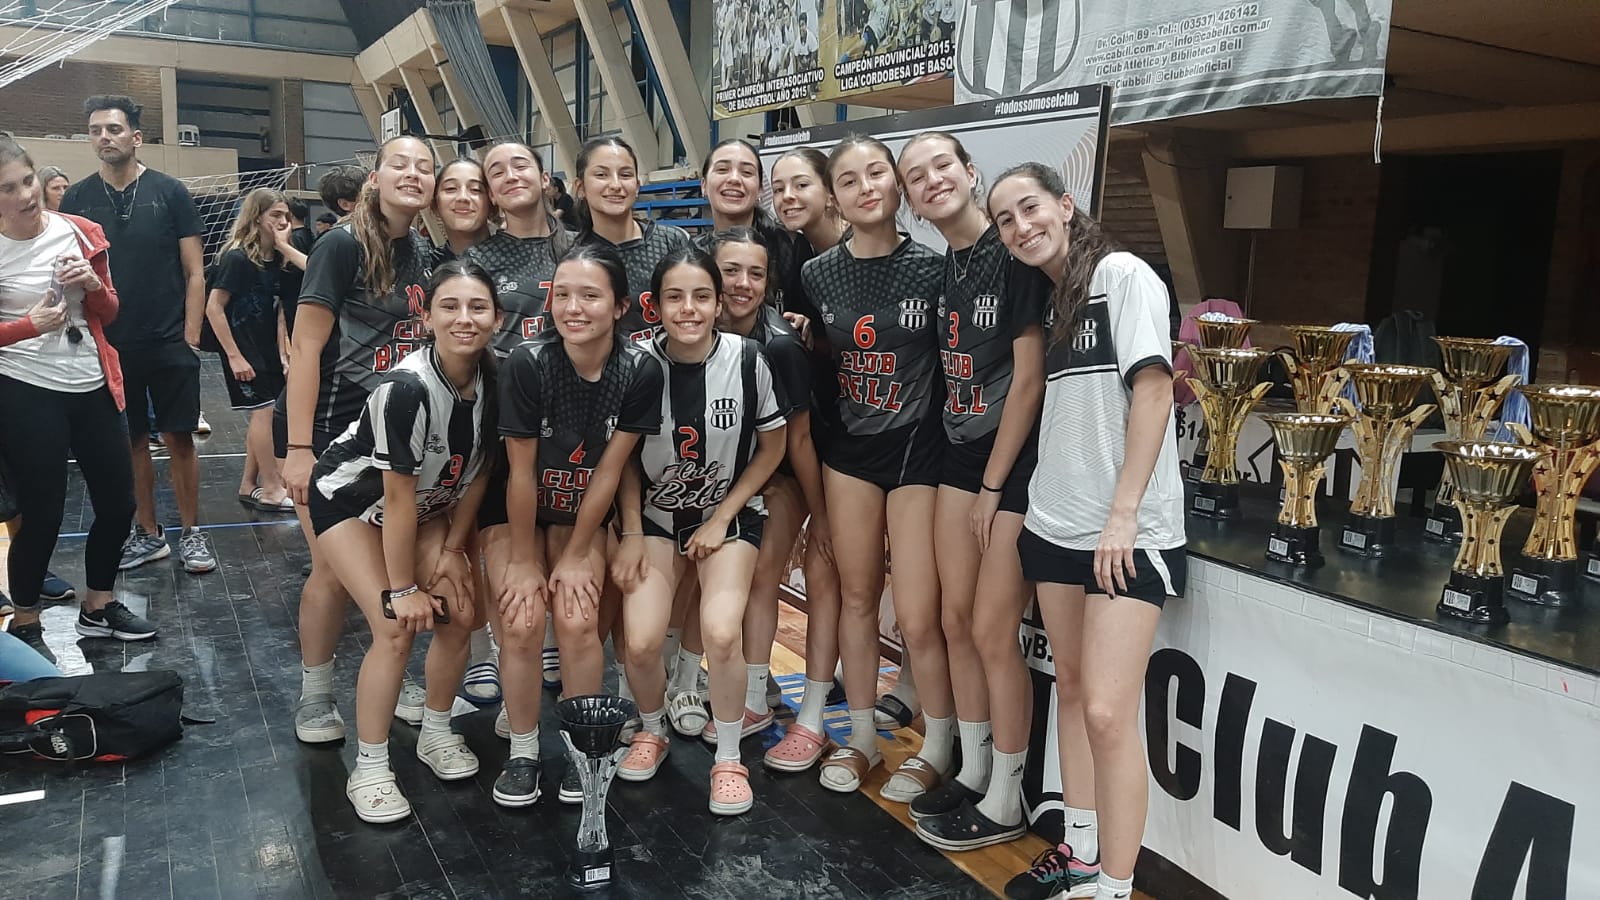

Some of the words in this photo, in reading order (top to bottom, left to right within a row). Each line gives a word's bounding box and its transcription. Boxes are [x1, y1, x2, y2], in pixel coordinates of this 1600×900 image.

[1136, 28, 1150, 40] 89
[1179, 13, 1216, 34] (03537)
[1218, 4, 1258, 20] 426142
[834, 55, 873, 77] CAMPEÓN
[874, 45, 925, 68] PROVINCIAL
[927, 39, 950, 57] 2015
[1161, 55, 1168, 66] y
[1170, 45, 1217, 62] Biblioteca
[1219, 38, 1243, 51] Bell
[716, 88, 737, 103] PRIMER
[736, 80, 765, 98] CAMPEÓN
[766, 68, 825, 92] INTERASOCIATIVO
[840, 74, 859, 91] LIGA
[860, 66, 912, 87] CORDOBESA
[913, 61, 926, 76] DE
[927, 55, 956, 73] BASQ
[728, 100, 737, 112] DE
[791, 85, 807, 99] 2015
[994, 90, 1080, 116] #todossomoselclub
[405, 283, 425, 316] 10
[639, 291, 662, 324] 8
[522, 316, 545, 340] CL
[853, 314, 876, 350] 6
[947, 311, 960, 349] 3
[840, 350, 897, 376] CLUB
[568, 439, 587, 465] 4
[678, 425, 700, 459] 2
[440, 453, 464, 487] 9
[543, 467, 595, 491] CLU
[649, 479, 731, 510] Bell
[1145, 648, 1433, 900] Club
